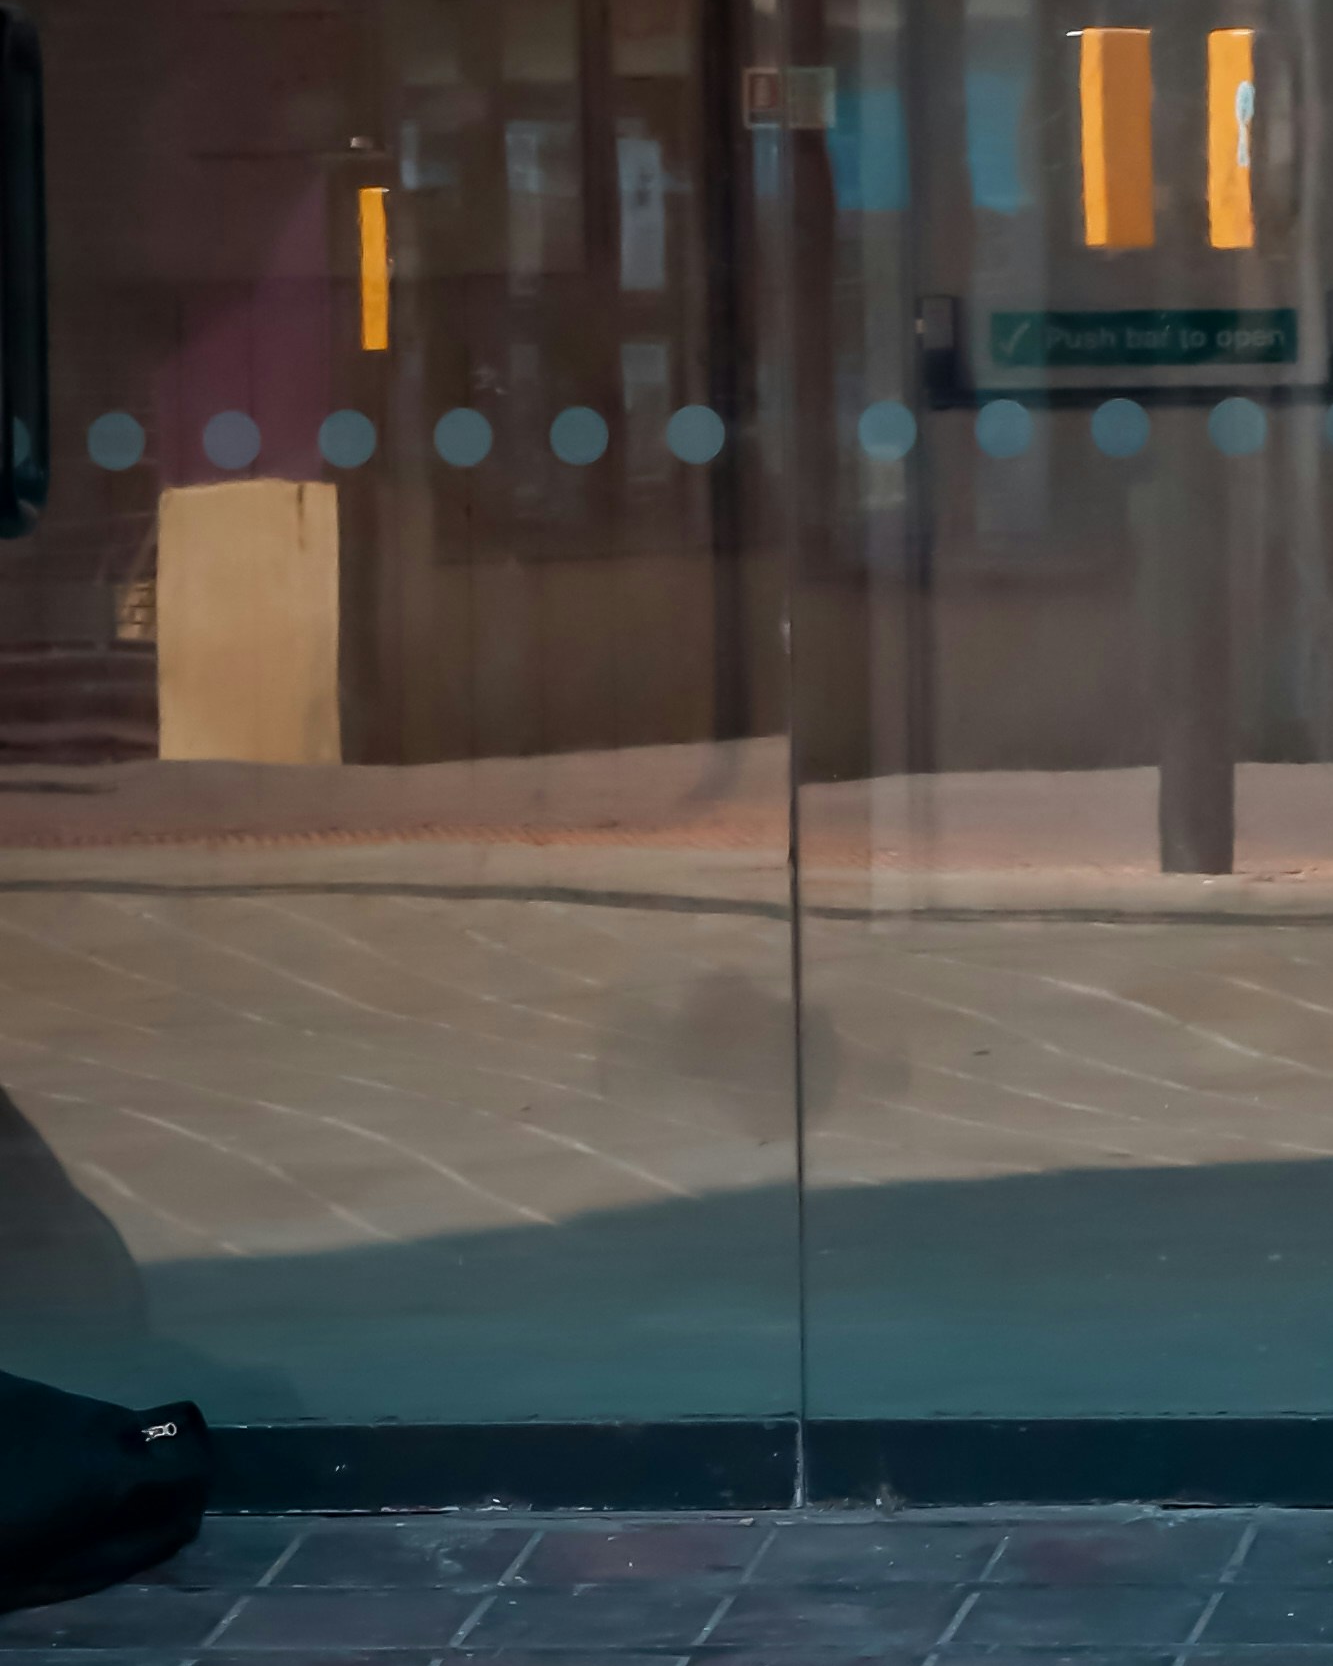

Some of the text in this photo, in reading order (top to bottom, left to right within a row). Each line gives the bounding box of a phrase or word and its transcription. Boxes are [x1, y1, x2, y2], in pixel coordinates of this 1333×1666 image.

[1046, 325, 1285, 355] Push bar to open
